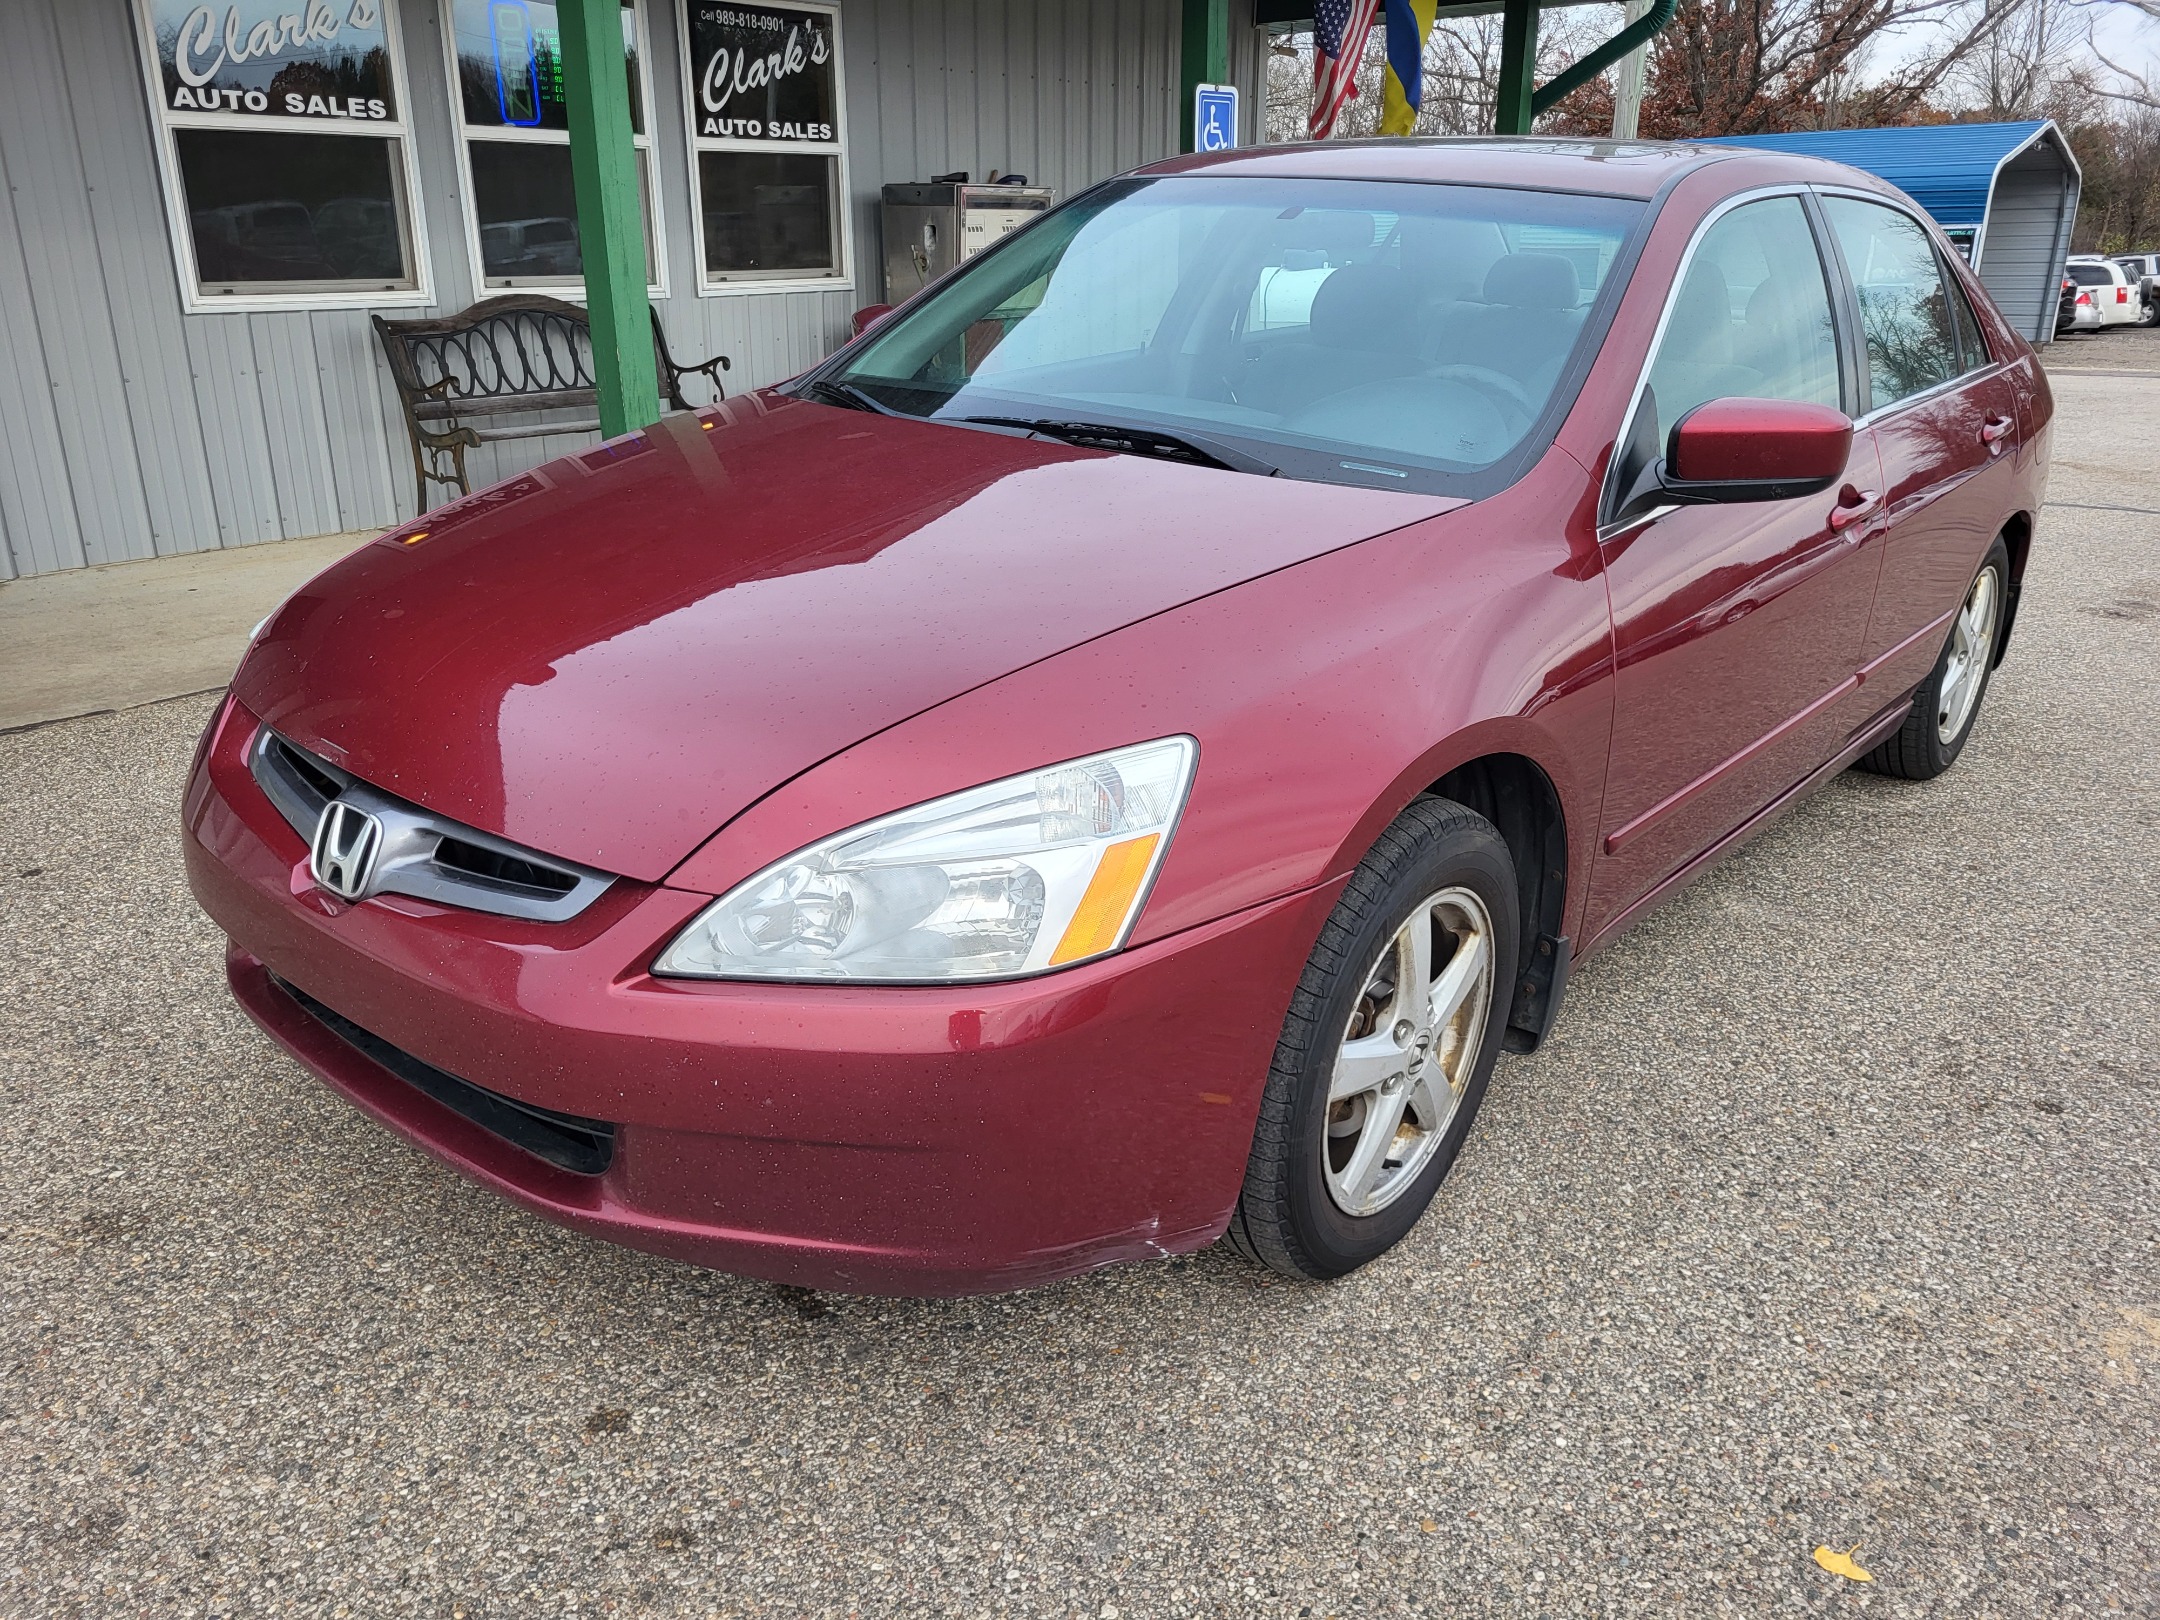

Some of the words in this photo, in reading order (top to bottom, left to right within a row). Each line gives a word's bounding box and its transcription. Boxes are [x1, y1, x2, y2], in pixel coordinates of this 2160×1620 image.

[700, 9, 715, 22] Cell
[716, 9, 785, 32] 989-818-0901
[175, 0, 377, 87] Clarks
[703, 18, 830, 113] Clark's
[173, 87, 268, 112] AUTO
[285, 93, 387, 119] SALES
[704, 118, 762, 136] AUTO
[768, 121, 832, 139] SALES
